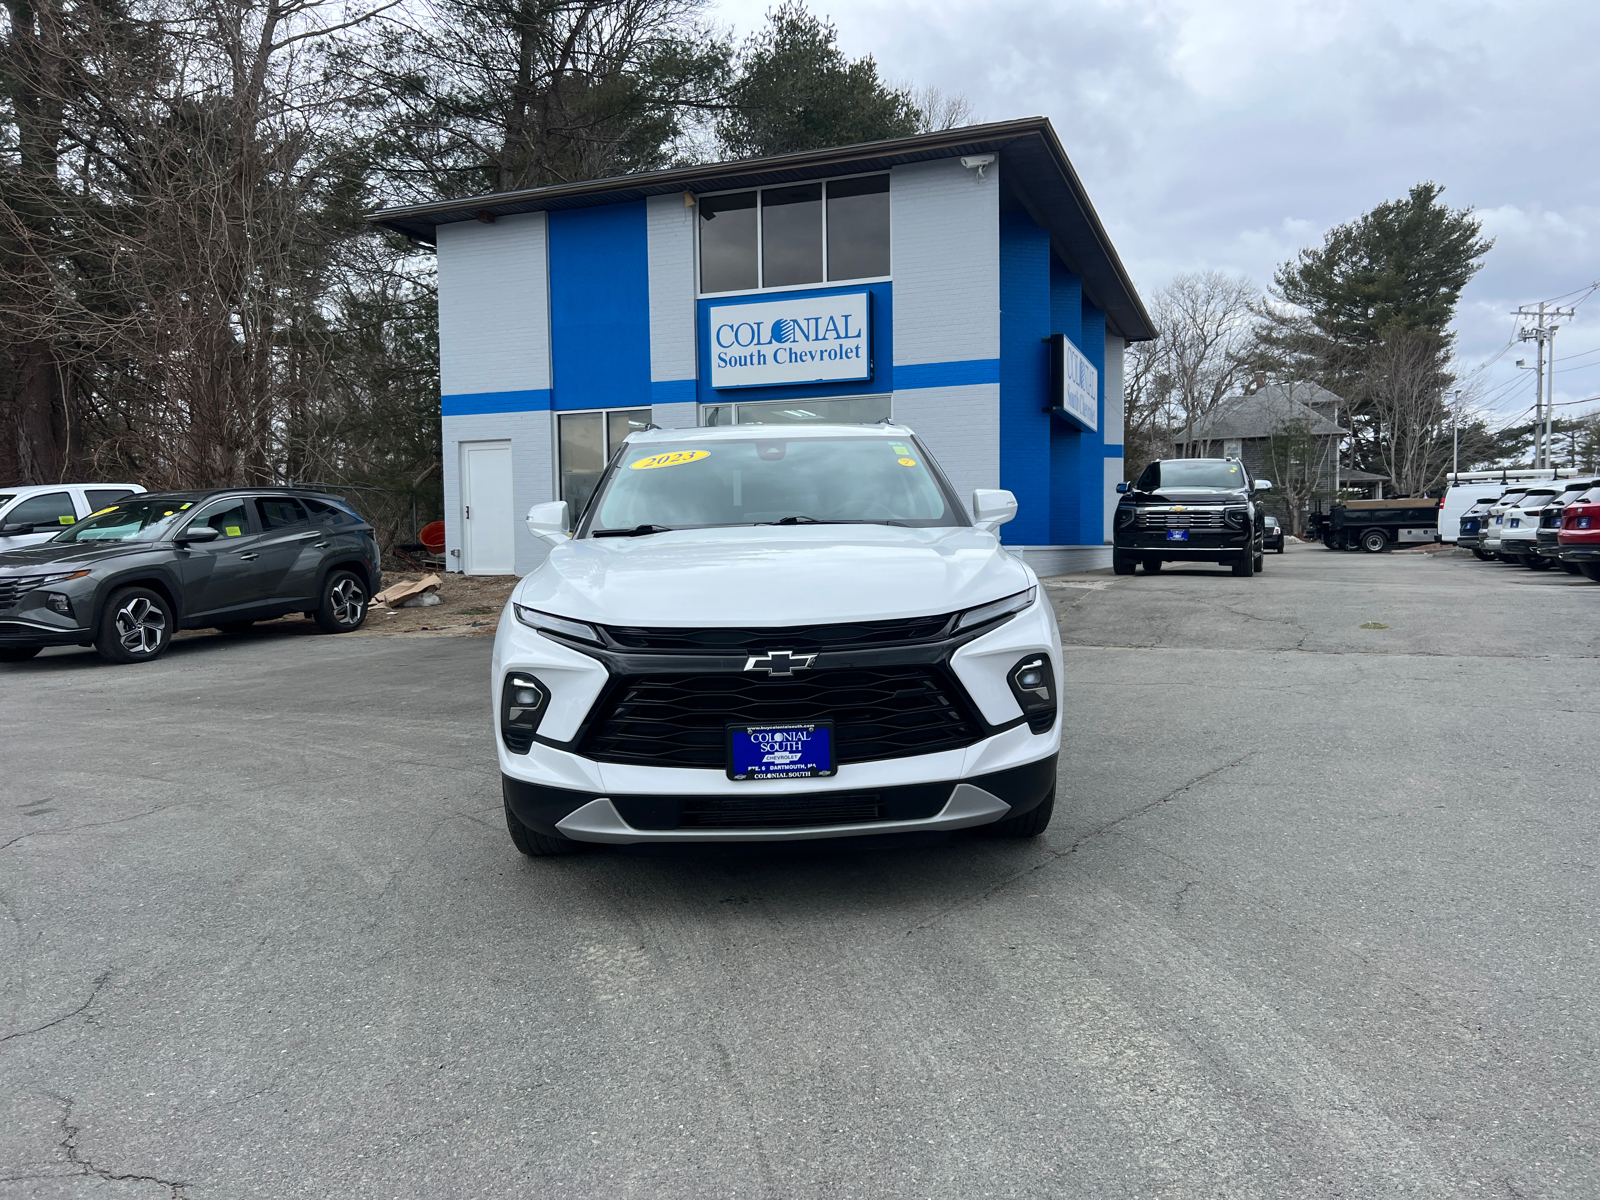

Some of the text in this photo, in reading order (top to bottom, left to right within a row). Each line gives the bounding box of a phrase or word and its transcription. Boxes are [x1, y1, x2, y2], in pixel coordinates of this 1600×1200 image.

[716, 314, 861, 348] COLONIAL
[718, 343, 861, 368] South Chevrolet
[643, 451, 696, 467] 2023
[751, 731, 811, 743] COLONIAL
[760, 742, 802, 752] SOUTH
